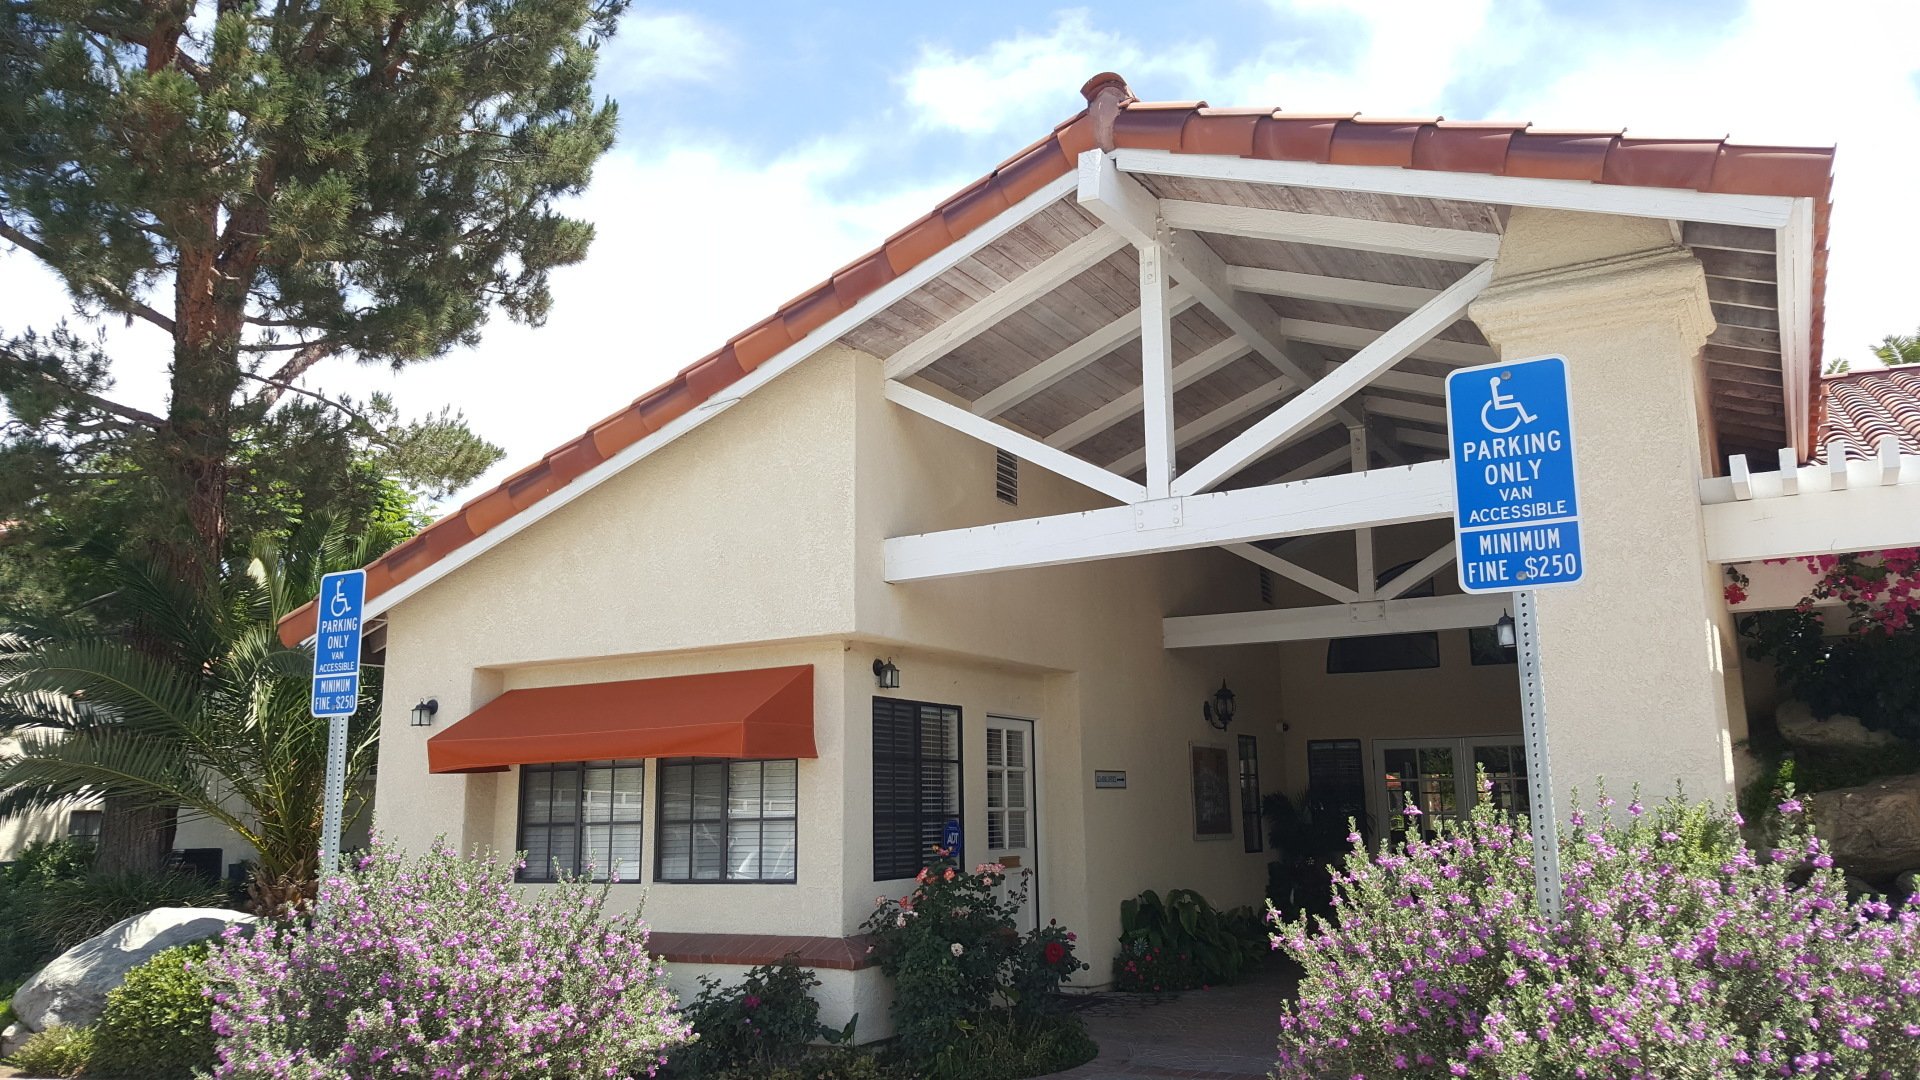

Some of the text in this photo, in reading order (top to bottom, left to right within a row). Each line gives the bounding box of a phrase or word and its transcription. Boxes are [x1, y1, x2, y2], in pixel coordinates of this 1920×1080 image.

[1463, 430, 1562, 463] PARKING
[1484, 458, 1542, 486] ONLY
[1499, 486, 1533, 502] VAN
[1469, 500, 1567, 523] ACCESSIBLE
[1479, 527, 1560, 556] MINIMUM
[1468, 553, 1577, 583] FINE $250
[321, 617, 358, 634] PARKING
[327, 635, 350, 649] ONLY
[331, 651, 344, 660] VAN
[318, 661, 355, 673] ACCESSIBLE
[320, 679, 351, 694] MINIMUM
[315, 695, 354, 711] FINE $250
[946, 832, 959, 845] ADT
